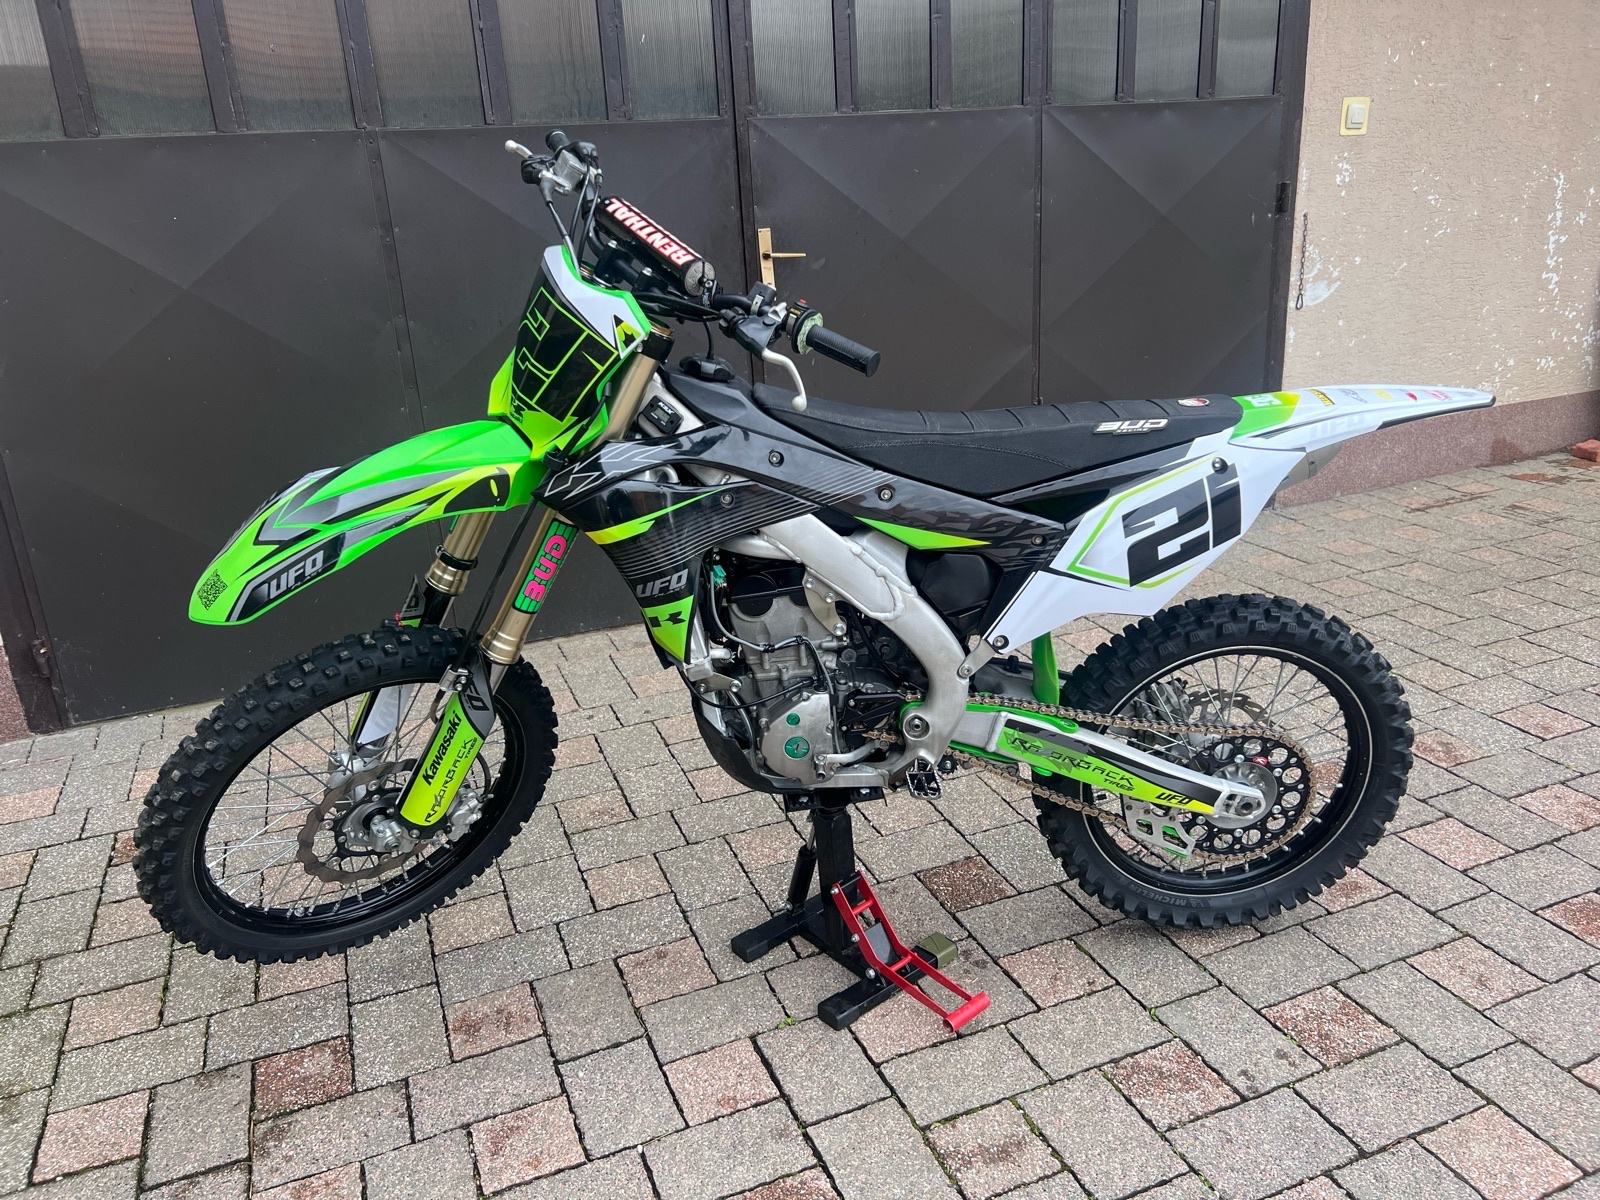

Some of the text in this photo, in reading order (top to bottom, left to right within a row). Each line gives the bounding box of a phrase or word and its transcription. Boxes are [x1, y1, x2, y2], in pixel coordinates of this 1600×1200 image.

[605, 198, 696, 266] RENTHAL
[1096, 419, 1169, 432] BUD
[269, 550, 324, 600] UFO
[524, 534, 569, 602] BUD
[636, 568, 689, 598] UFO
[422, 710, 463, 786] Kawasaki
[1103, 778, 1136, 792] TIRES
[1155, 792, 1192, 805] UFO
